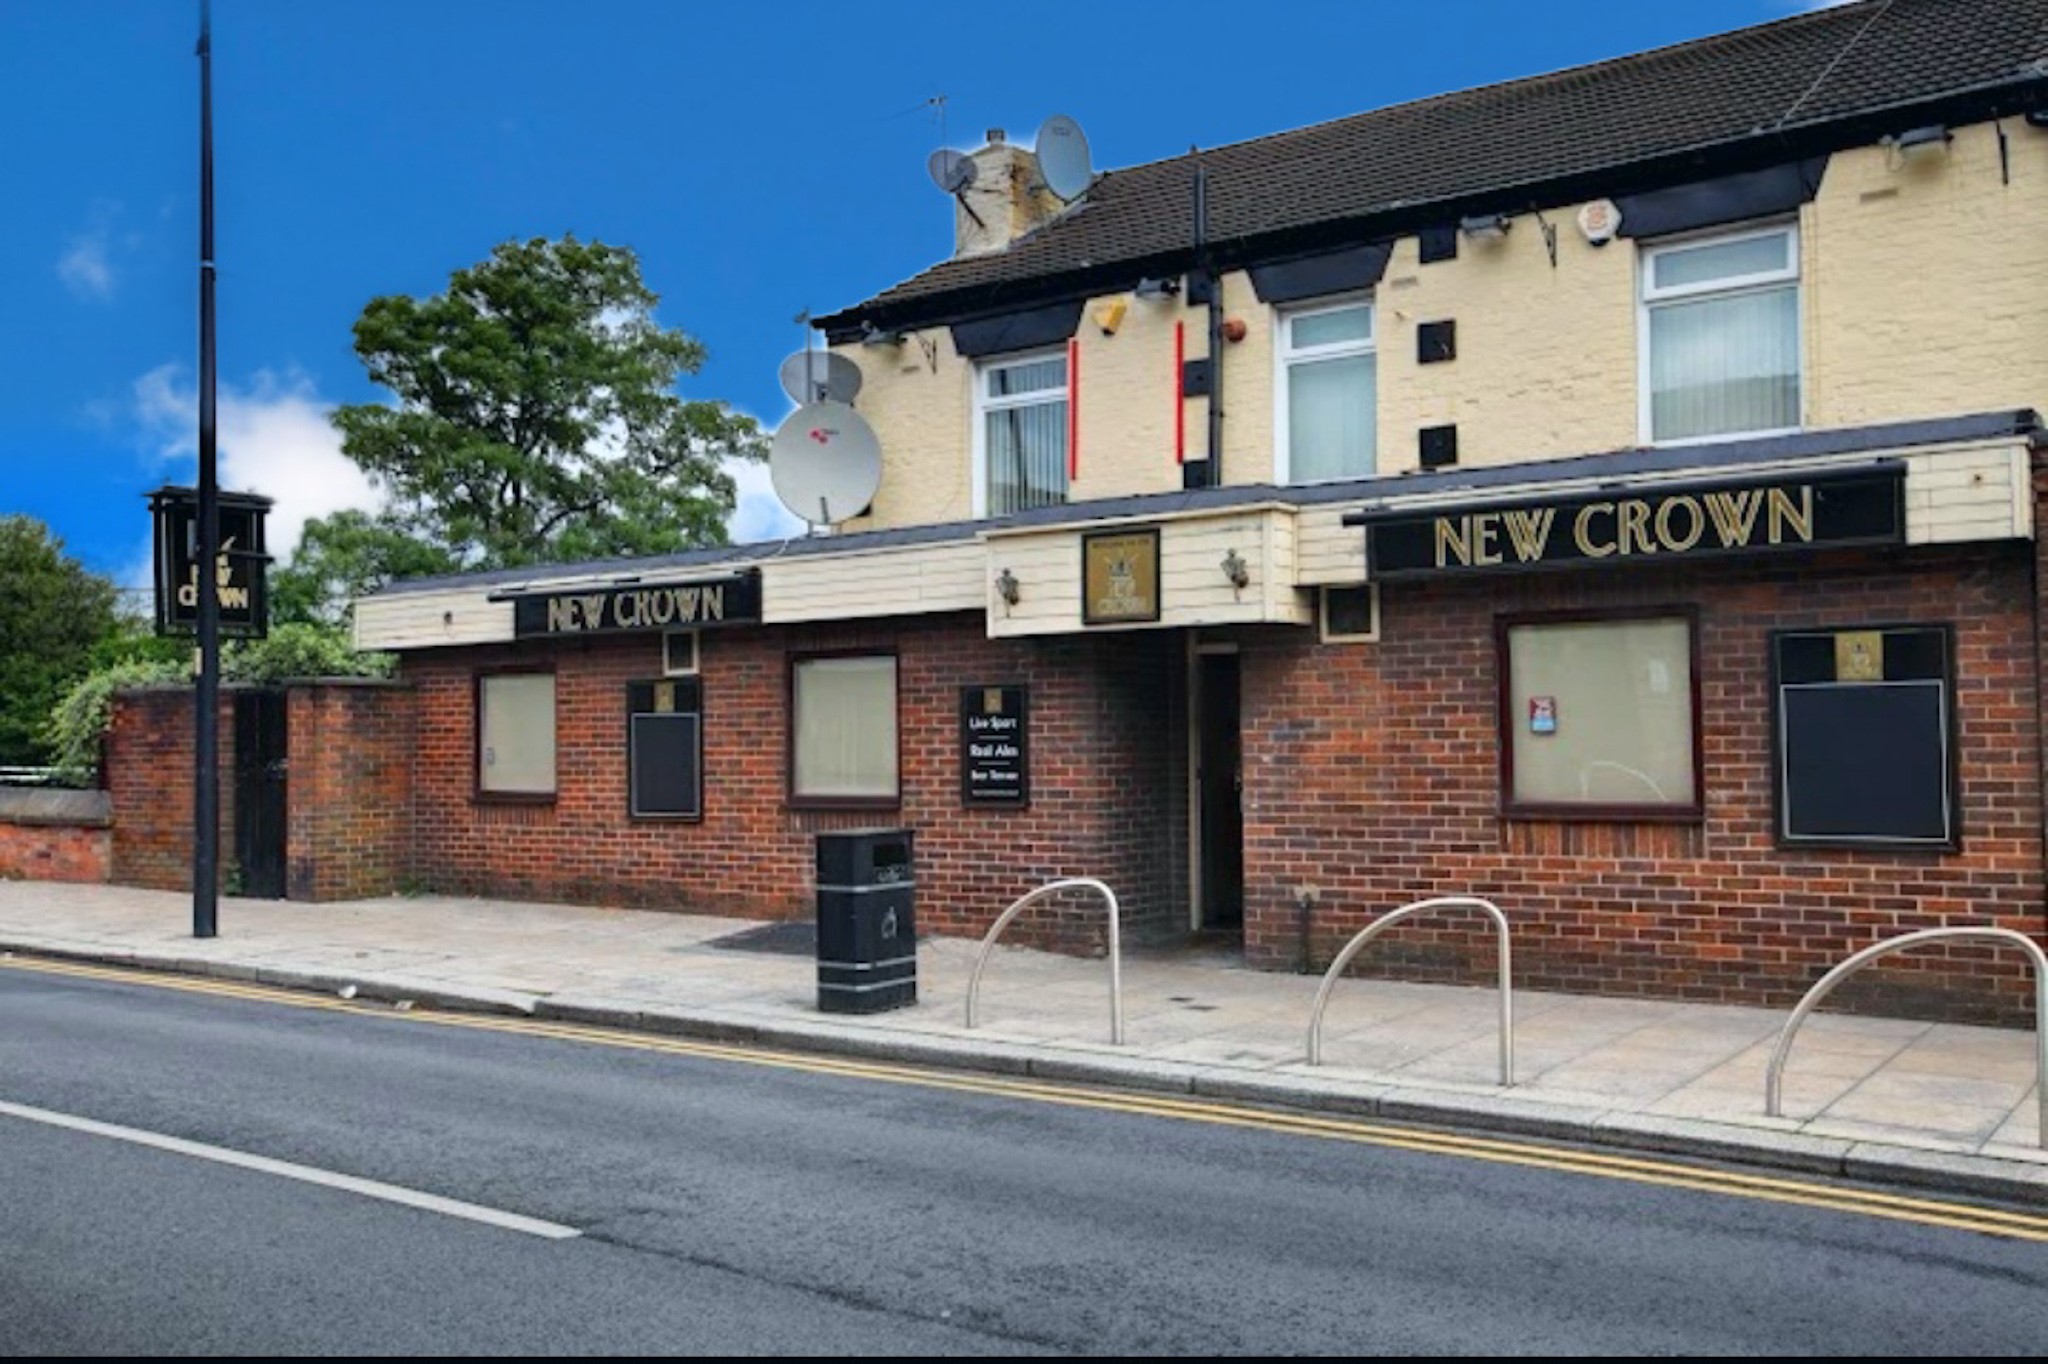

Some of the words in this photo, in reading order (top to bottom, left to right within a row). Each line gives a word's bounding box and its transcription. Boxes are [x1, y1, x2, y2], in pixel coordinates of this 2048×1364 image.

[1435, 508, 1555, 568] NEW
[1574, 485, 1813, 558] CROWN
[548, 594, 606, 632] NEW
[613, 585, 724, 628] CROWN
